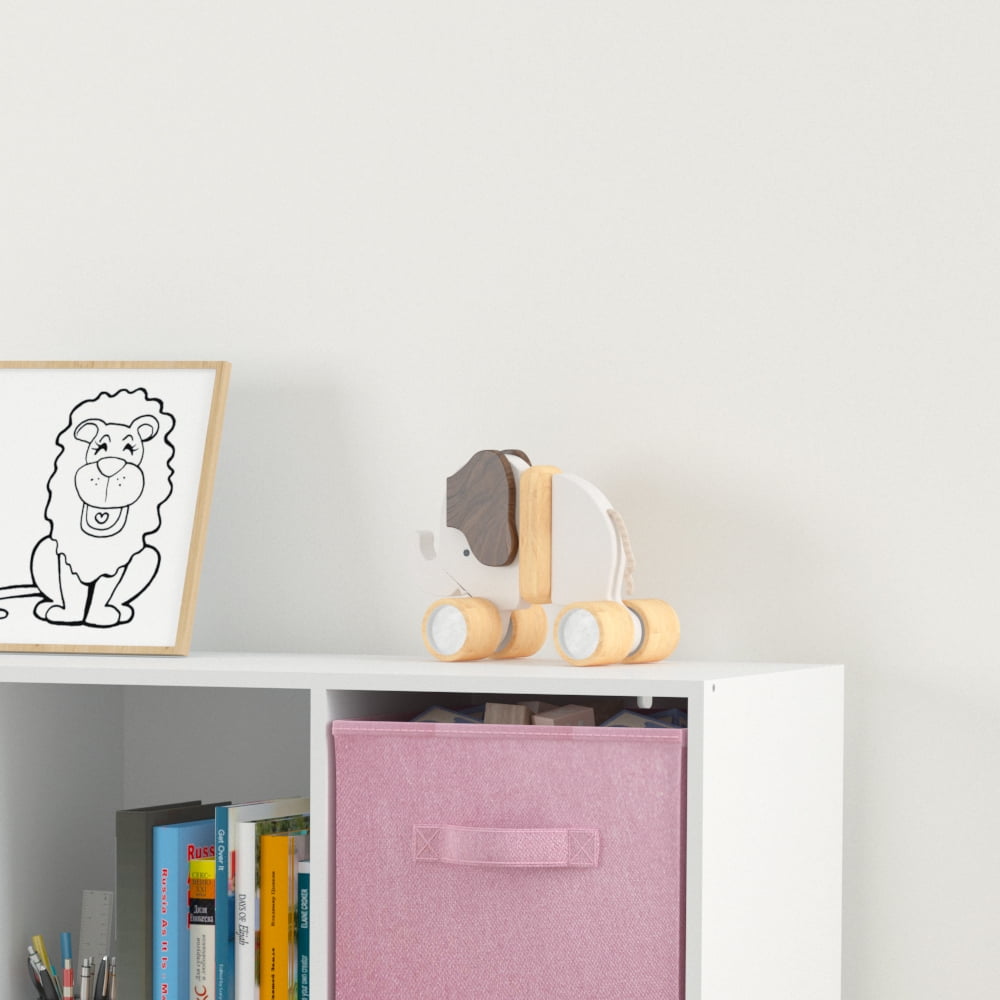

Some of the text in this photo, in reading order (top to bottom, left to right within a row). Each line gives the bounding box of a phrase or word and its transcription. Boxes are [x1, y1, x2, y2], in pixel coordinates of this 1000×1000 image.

[217, 829, 225, 844] Get
[187, 844, 216, 862] Russ
[217, 845, 225, 864] Over
[161, 868, 169, 914] Russia
[161, 919, 169, 936] As
[235, 894, 249, 946] DAYS OF Elijah
[161, 941, 169, 952] It
[161, 957, 169, 970] Is
